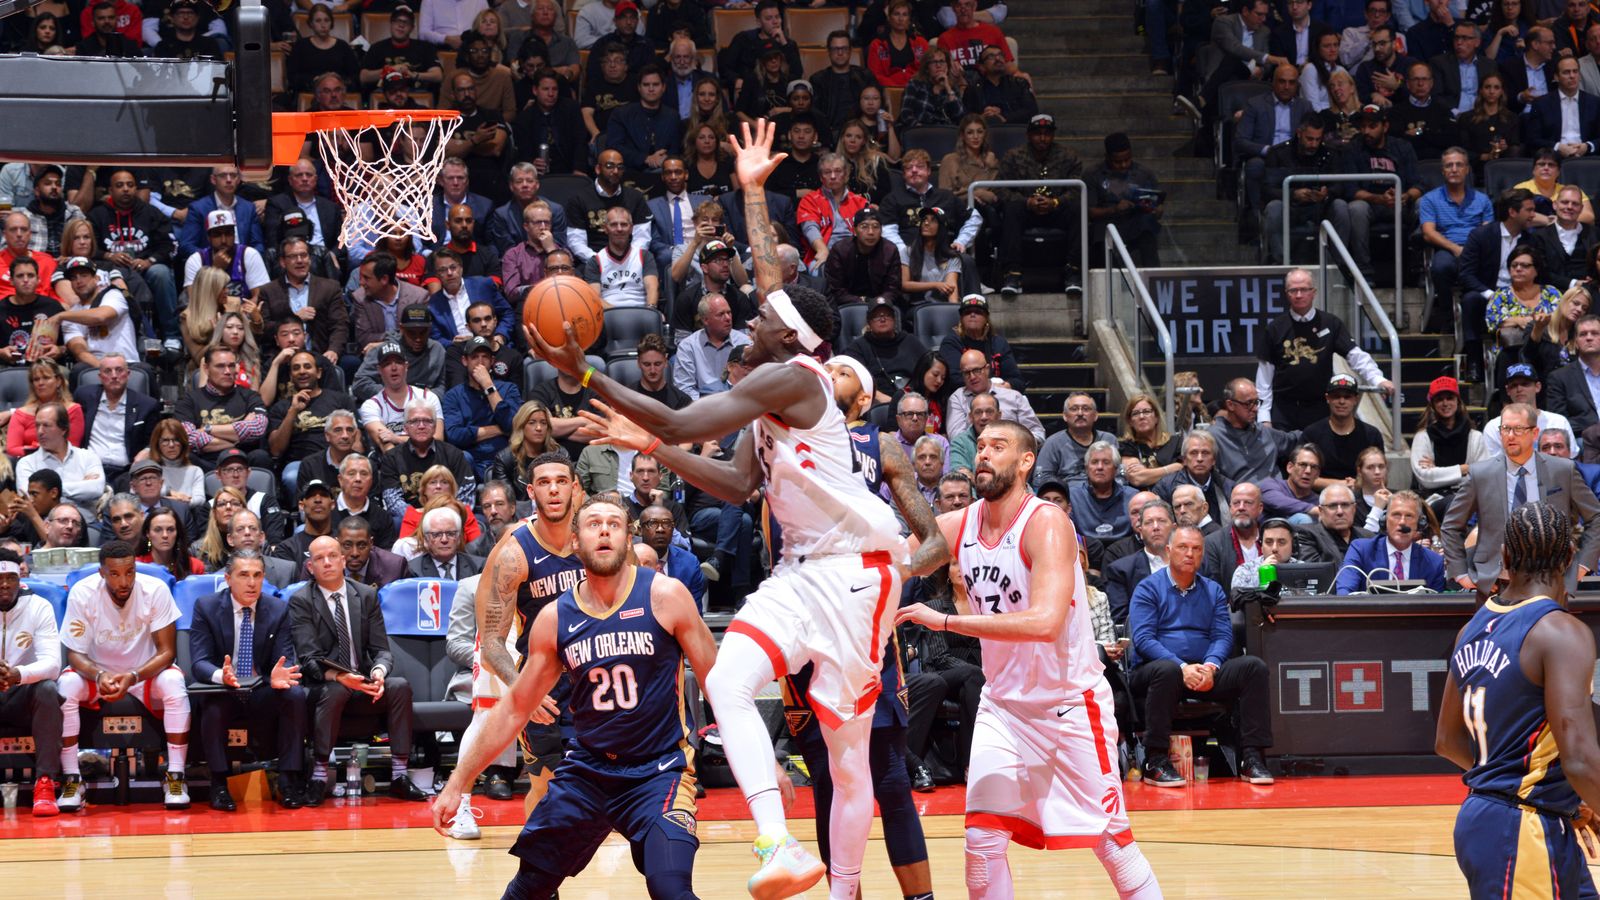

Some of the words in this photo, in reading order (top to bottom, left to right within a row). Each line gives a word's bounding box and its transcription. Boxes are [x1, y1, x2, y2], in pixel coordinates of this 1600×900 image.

[602, 270, 642, 290] RAPTORS
[1156, 280, 1199, 315] WE
[1214, 277, 1284, 315] THE
[1157, 319, 1261, 354] NORT
[530, 573, 557, 599] NEW
[964, 565, 1022, 604] APTORS
[564, 637, 593, 671] NEW
[595, 631, 656, 660] ORLEANS
[588, 663, 639, 712] 20
